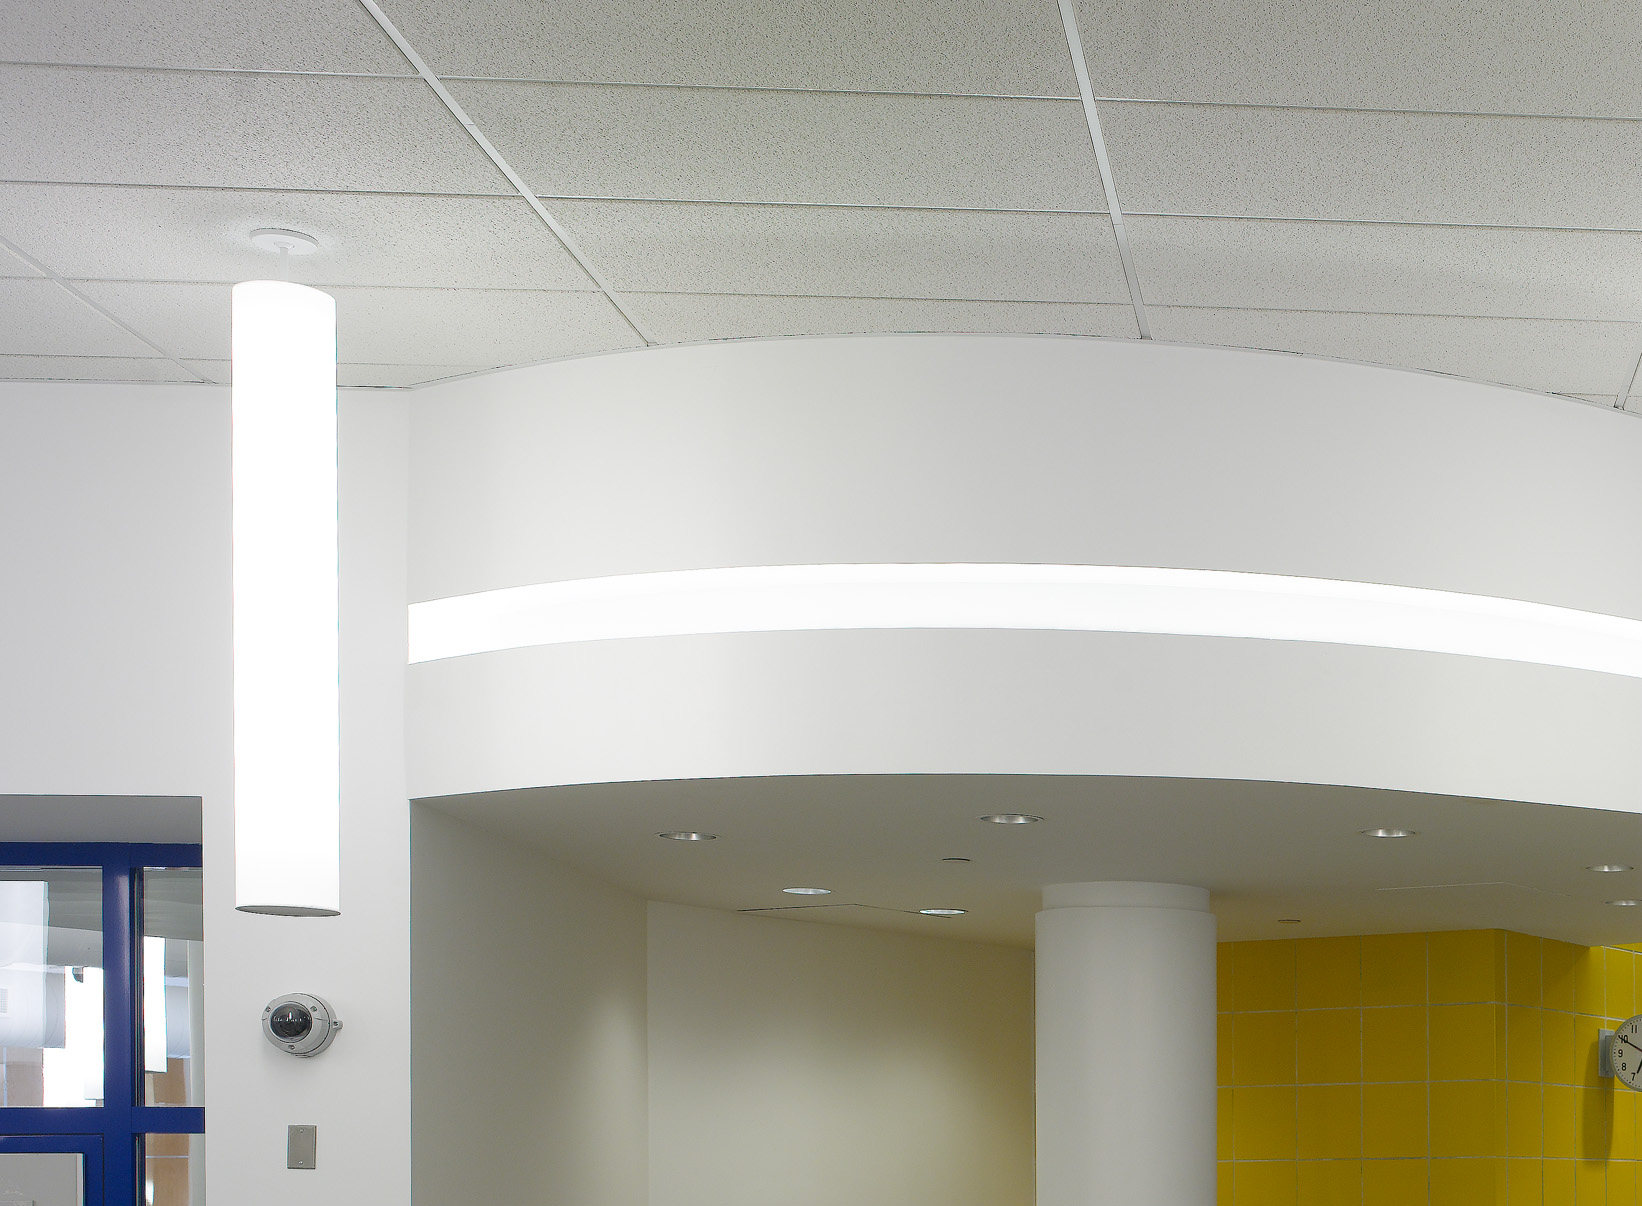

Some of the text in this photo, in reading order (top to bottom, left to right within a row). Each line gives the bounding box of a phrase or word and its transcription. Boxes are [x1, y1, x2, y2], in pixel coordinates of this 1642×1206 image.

[1631, 1025, 1638, 1034] 11
[1620, 1035, 1629, 1043] 10
[1617, 1050, 1623, 1058] 9
[1621, 1063, 1627, 1071] 8
[1630, 1073, 1636, 1081] 7
